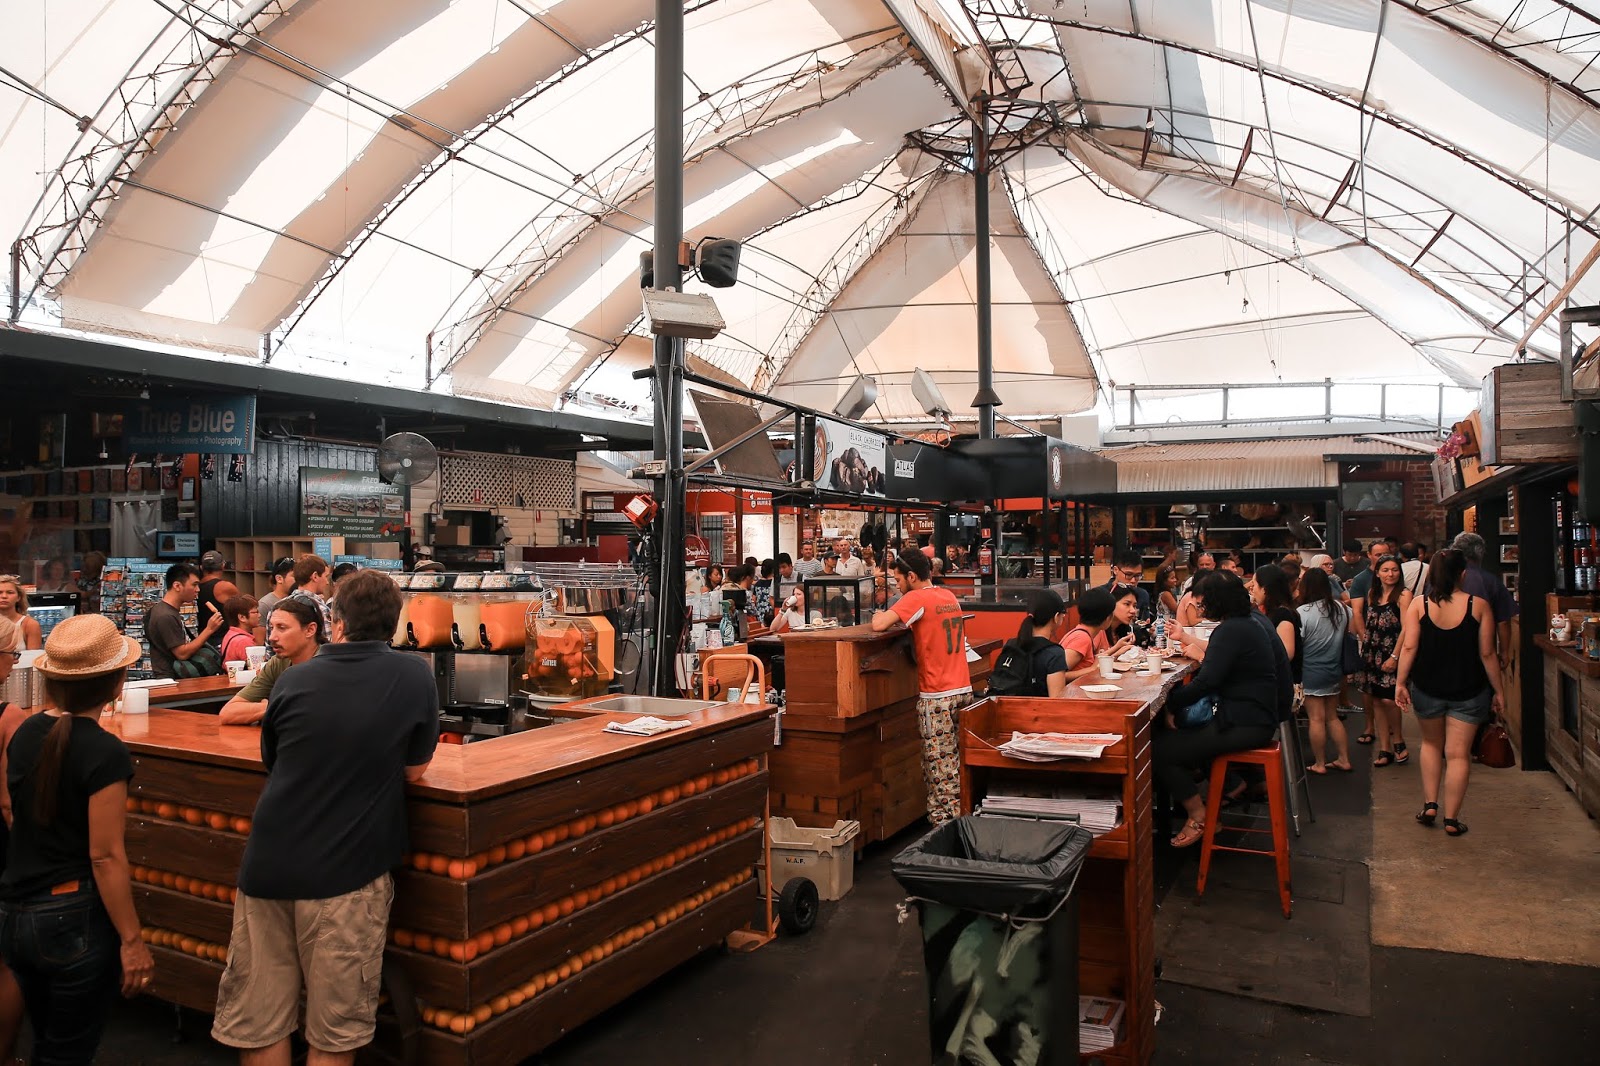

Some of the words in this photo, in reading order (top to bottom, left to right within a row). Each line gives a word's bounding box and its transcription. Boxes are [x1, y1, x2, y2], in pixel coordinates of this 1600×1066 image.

[137, 404, 182, 434] True
[187, 403, 235, 434] Blue
[204, 435, 242, 446] Photography
[896, 460, 914, 472] ATLAS
[942, 616, 963, 655] 17
[785, 857, 806, 865] W.A.F.
